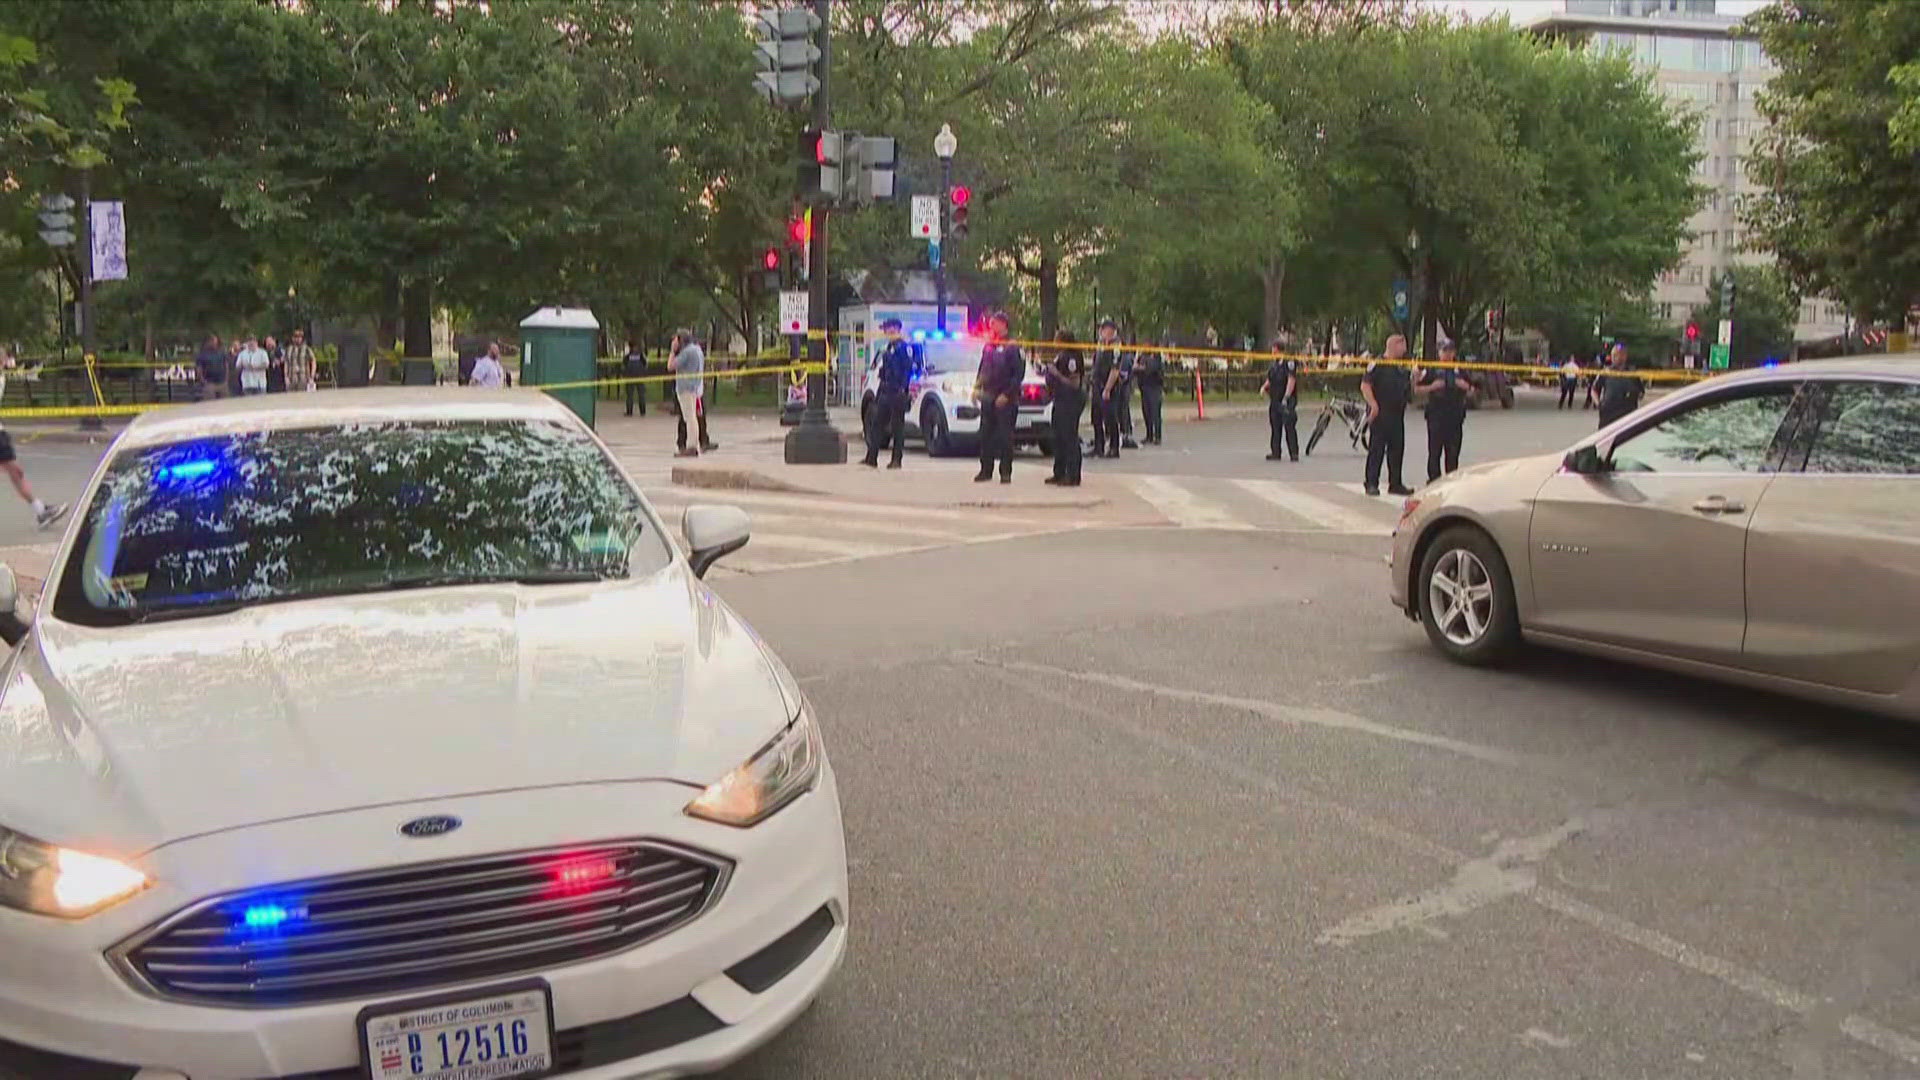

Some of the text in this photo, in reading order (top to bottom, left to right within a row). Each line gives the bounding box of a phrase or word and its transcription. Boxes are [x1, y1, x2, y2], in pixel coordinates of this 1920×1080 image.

[919, 199, 932, 208] NO
[788, 295, 802, 303] NO
[411, 817, 448, 834] Ford
[399, 1001, 514, 1030] DISTRICT OF COLUMBIA
[437, 1018, 528, 1071] 12516
